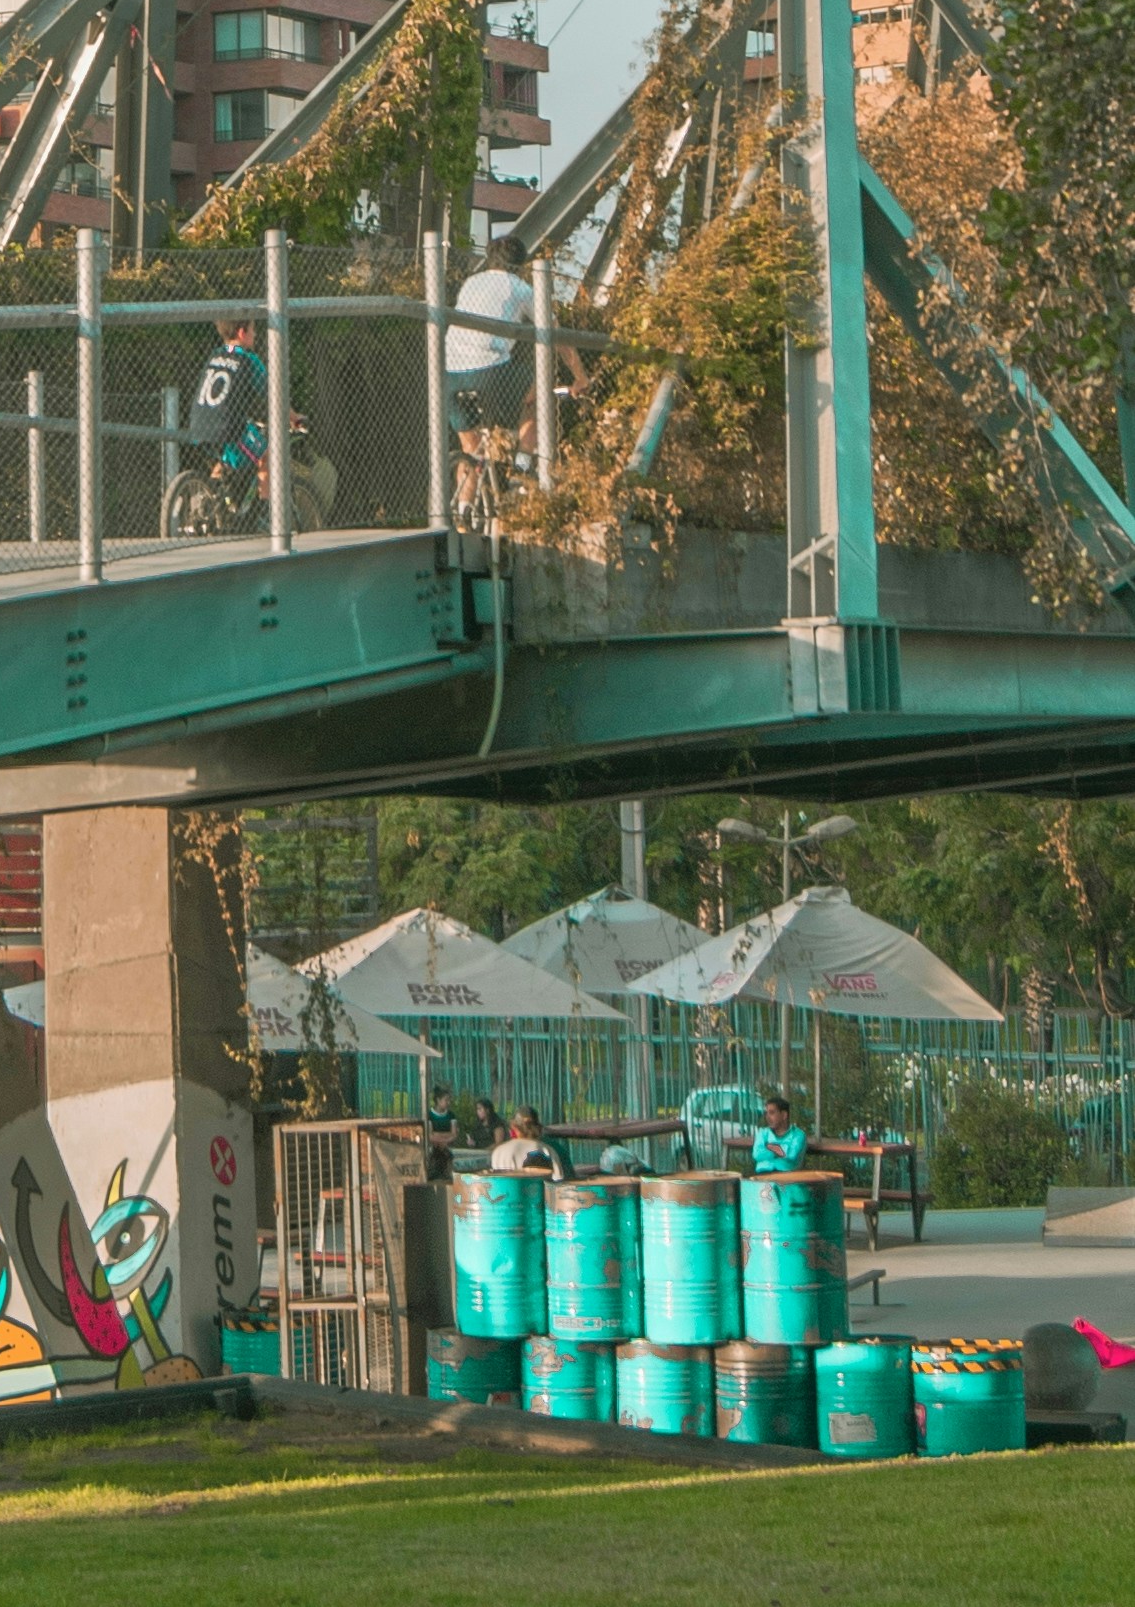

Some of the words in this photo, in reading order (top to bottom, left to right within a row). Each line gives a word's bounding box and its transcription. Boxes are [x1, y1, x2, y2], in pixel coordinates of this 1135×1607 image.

[198, 369, 231, 407] 10
[822, 972, 878, 990] VANS
[407, 983, 480, 995] BOWL
[411, 993, 485, 1005] PARK
